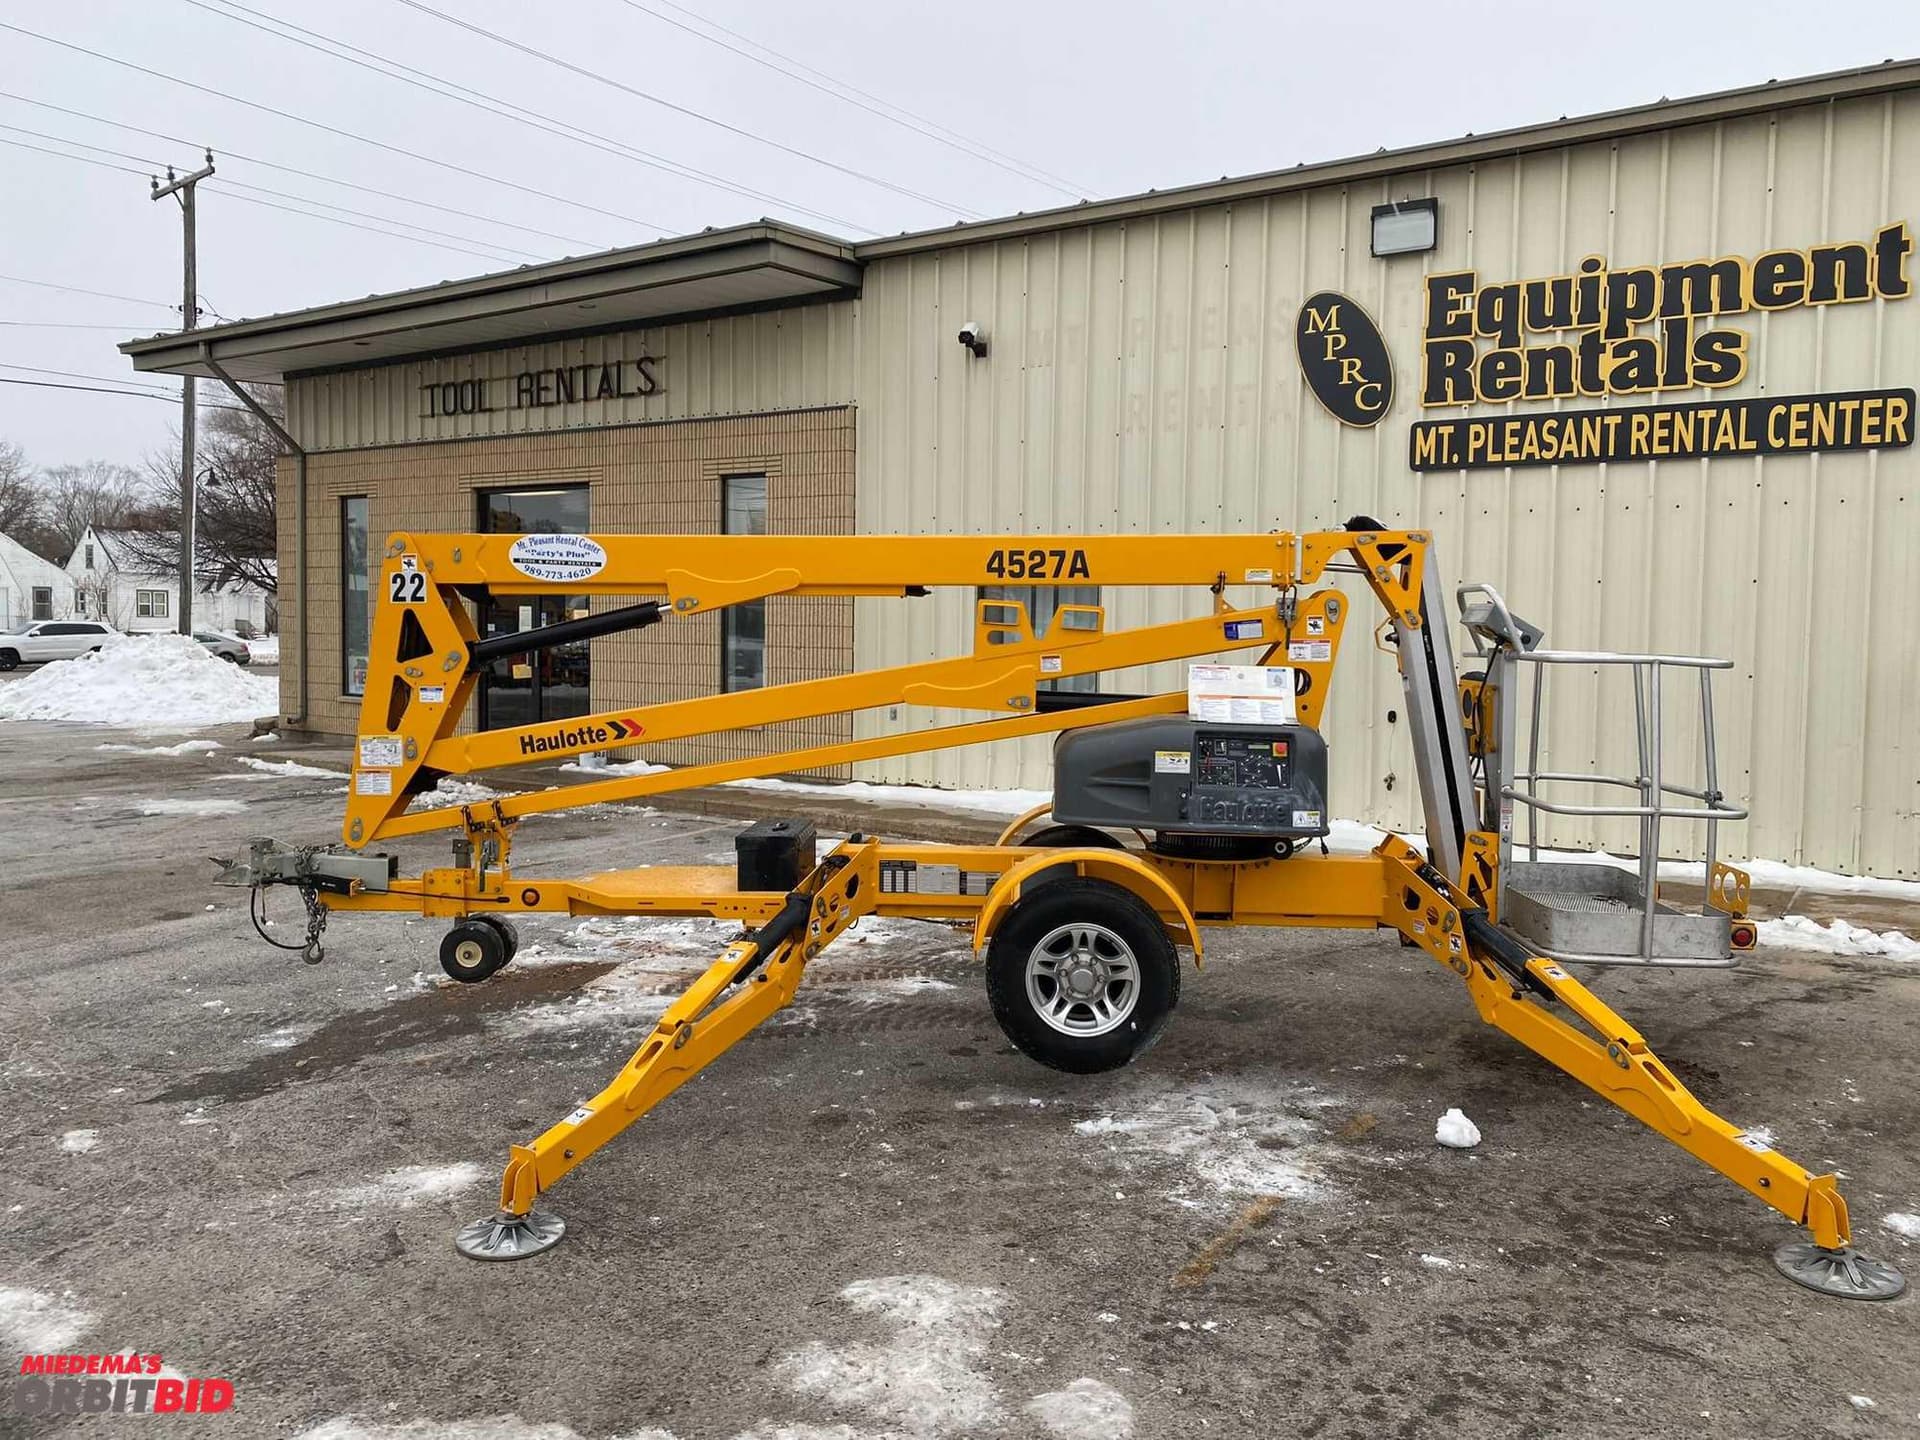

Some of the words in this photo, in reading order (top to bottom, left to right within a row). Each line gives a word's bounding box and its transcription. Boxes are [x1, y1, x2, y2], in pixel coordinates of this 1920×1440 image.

[1426, 222, 1911, 348] Equipment
[1424, 317, 1748, 407] Rentals
[427, 378, 493, 418] TOOL
[517, 356, 656, 409] RENTALS
[1415, 425, 1459, 465] MT.
[1468, 415, 1622, 463] PLEASANT
[1631, 407, 1757, 456] RENTAL
[1767, 397, 1909, 447] CENTER
[516, 541, 529, 551] Mt.
[529, 536, 554, 547] Pleasant
[556, 536, 578, 547] Rental
[579, 538, 601, 555] Center
[524, 565, 592, 580] 989-773-4620
[986, 550, 1090, 579] 4527A
[392, 573, 425, 602] 22
[520, 726, 608, 755] Haulotte
